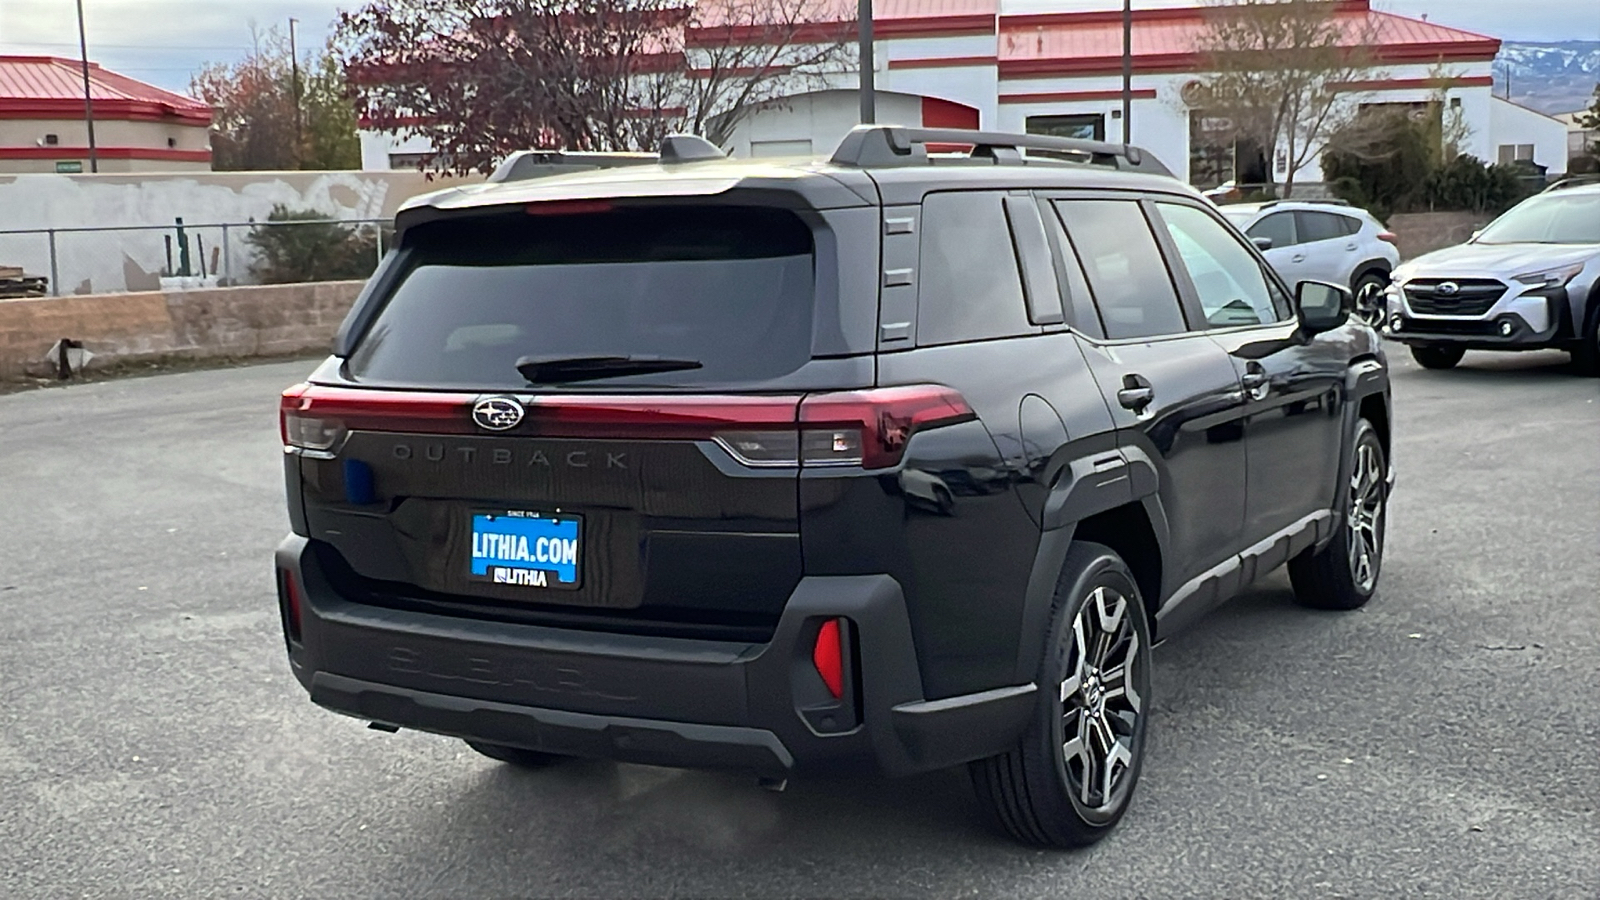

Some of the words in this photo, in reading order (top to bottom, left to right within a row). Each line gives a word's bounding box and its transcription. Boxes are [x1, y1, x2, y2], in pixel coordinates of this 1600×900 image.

[392, 444, 628, 469] OUTBACK
[472, 532, 578, 565] LITHIA.COM
[506, 569, 547, 587] LITHIA
